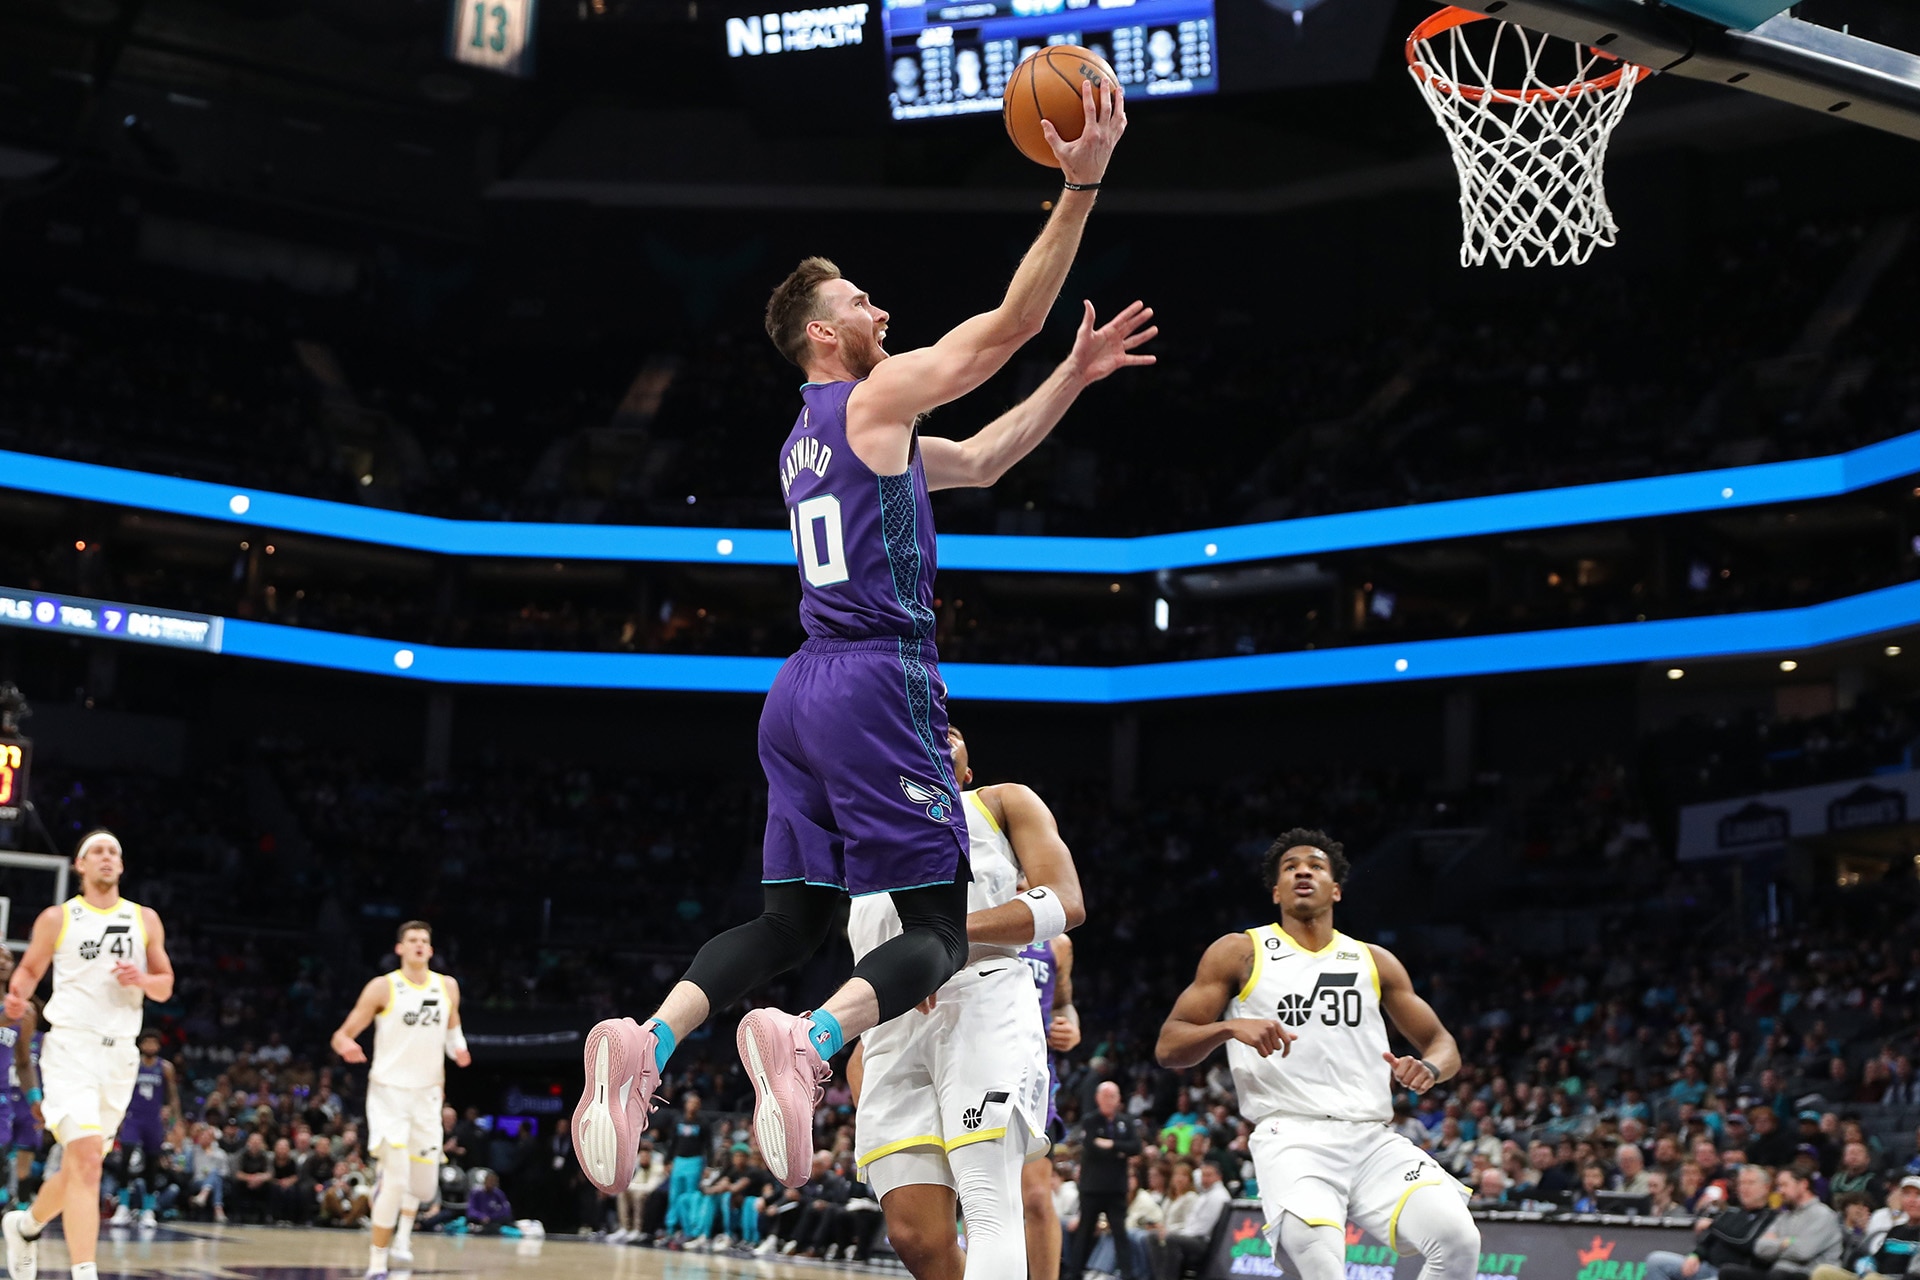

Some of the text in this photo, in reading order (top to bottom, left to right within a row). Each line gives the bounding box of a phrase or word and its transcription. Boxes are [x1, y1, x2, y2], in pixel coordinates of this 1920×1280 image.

[472, 3, 507, 52] 13
[103, 610, 122, 631] 7
[110, 936, 132, 958] 41
[421, 1006, 440, 1026] 24
[1319, 989, 1362, 1027] 30
